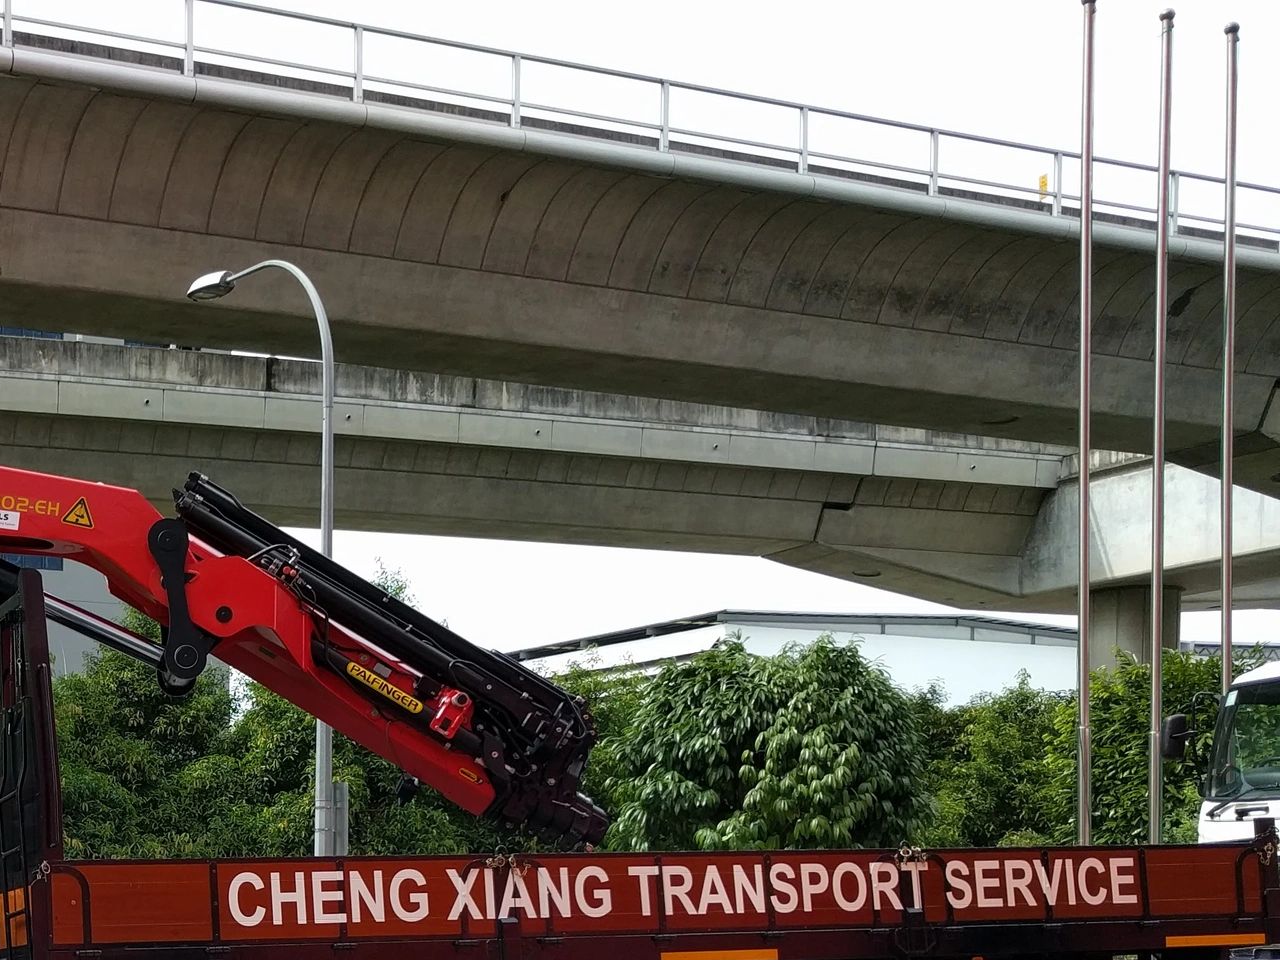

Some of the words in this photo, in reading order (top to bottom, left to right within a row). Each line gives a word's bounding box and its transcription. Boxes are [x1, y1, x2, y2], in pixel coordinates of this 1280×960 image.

[349, 664, 420, 712] PALFINGER
[228, 870, 429, 927] CHENG
[446, 866, 612, 921] XIANG
[627, 861, 929, 916] TRANSPORT
[946, 857, 1138, 909] SERVICE
